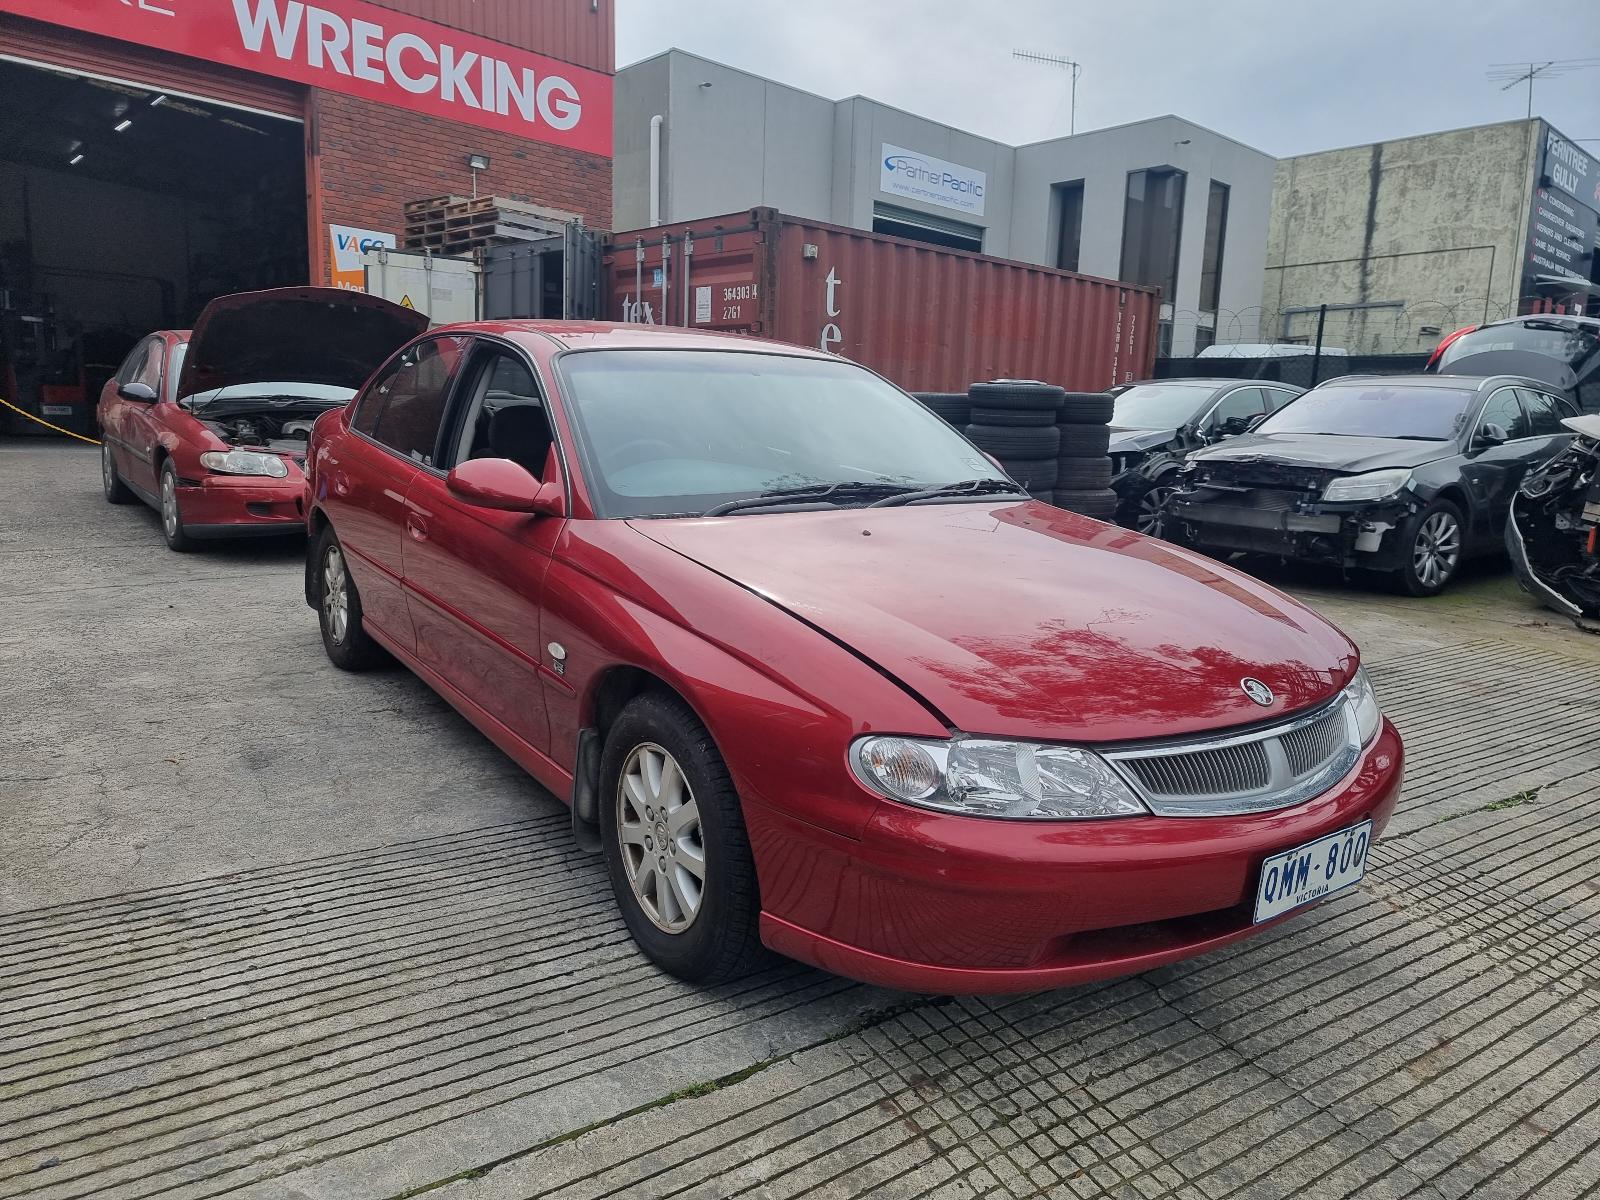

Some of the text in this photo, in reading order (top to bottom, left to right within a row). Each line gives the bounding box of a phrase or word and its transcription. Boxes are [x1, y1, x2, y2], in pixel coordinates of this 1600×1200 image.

[231, 0, 582, 131] WRECKING
[1547, 131, 1588, 176] FERNTREE
[1553, 163, 1579, 194] GULLY
[1549, 196, 1575, 217] CONDITIONING
[1536, 222, 1554, 238] REPAIRS
[1554, 231, 1562, 243] AND
[1535, 238, 1572, 263] SAME DAY SERVICE
[1533, 254, 1554, 270] AUSTRALIA
[1554, 263, 1565, 275] WIDE
[723, 286, 750, 302] 364303
[722, 305, 741, 320] 22G1
[1296, 883, 1329, 904] VICTORIA
